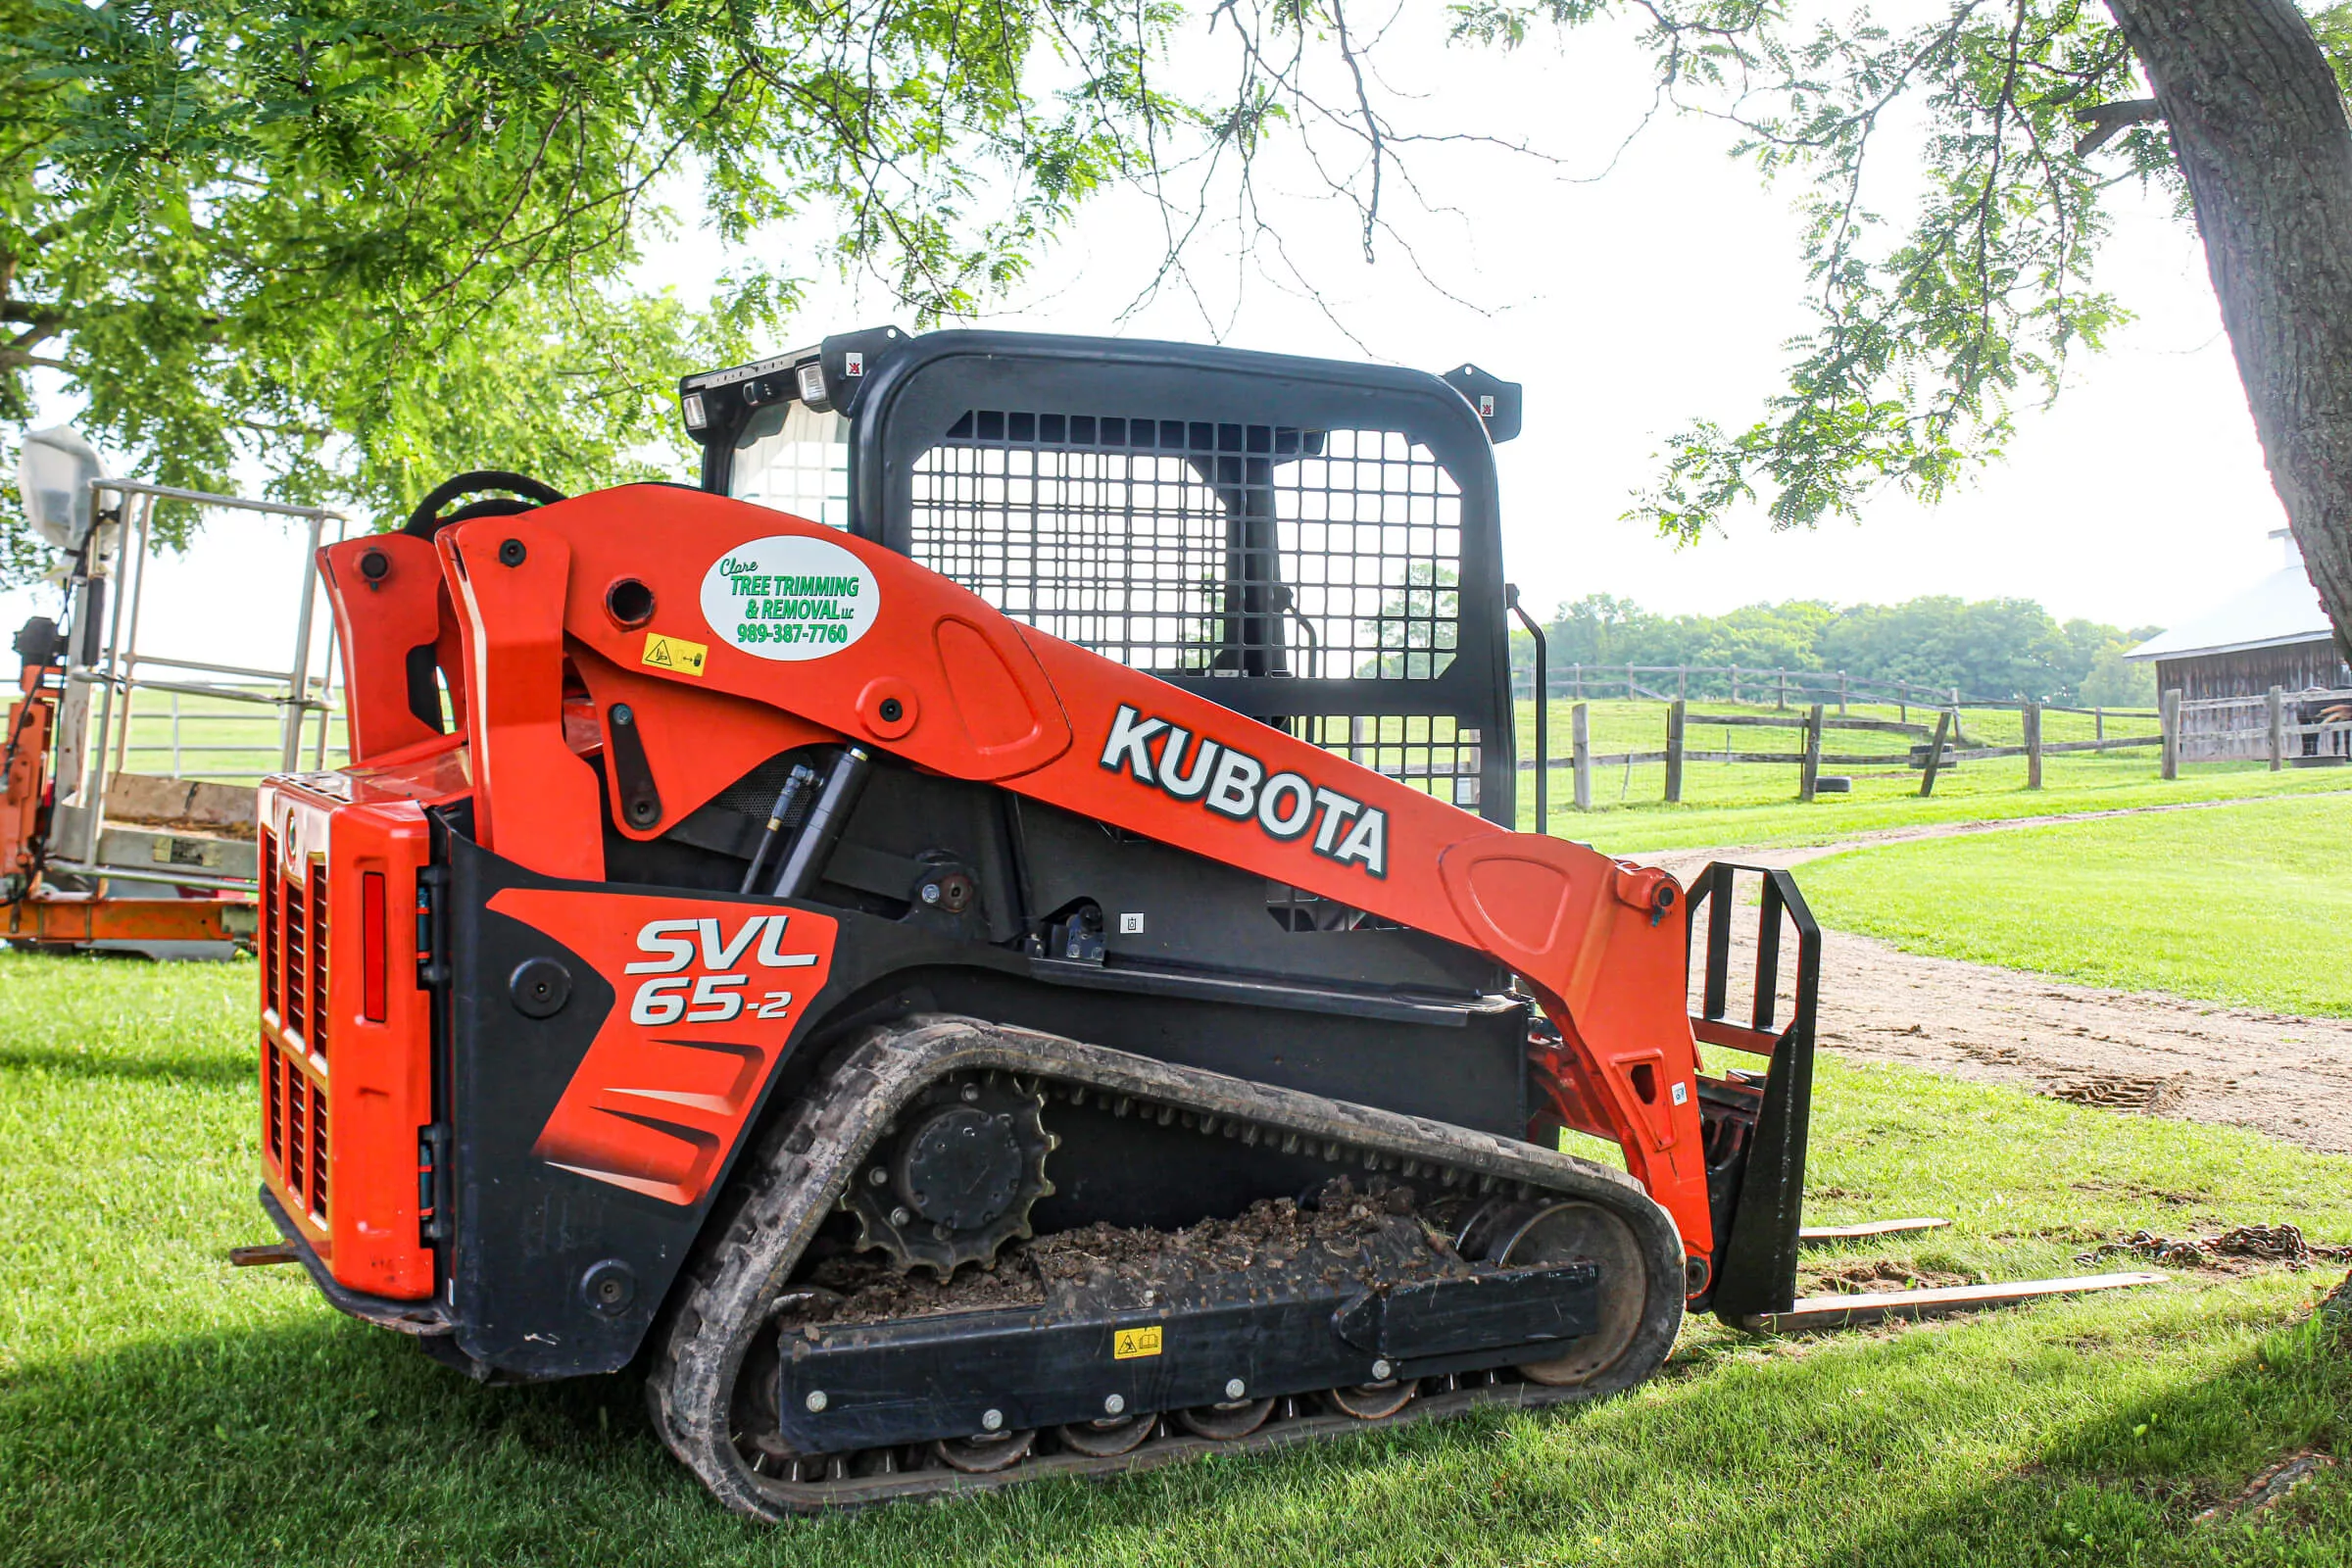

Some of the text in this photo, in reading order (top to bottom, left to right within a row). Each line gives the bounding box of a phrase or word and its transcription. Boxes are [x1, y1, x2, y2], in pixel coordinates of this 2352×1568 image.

[719, 557, 759, 576] Clare
[730, 574, 859, 597] TREE TRIMMING
[745, 598, 760, 619] &
[760, 599, 841, 619] REMOVAL
[737, 623, 849, 644] 989-387-7760
[1099, 703, 1388, 880] KUBOTA
[623, 915, 818, 975] SVL
[630, 974, 792, 1026] 65-2
